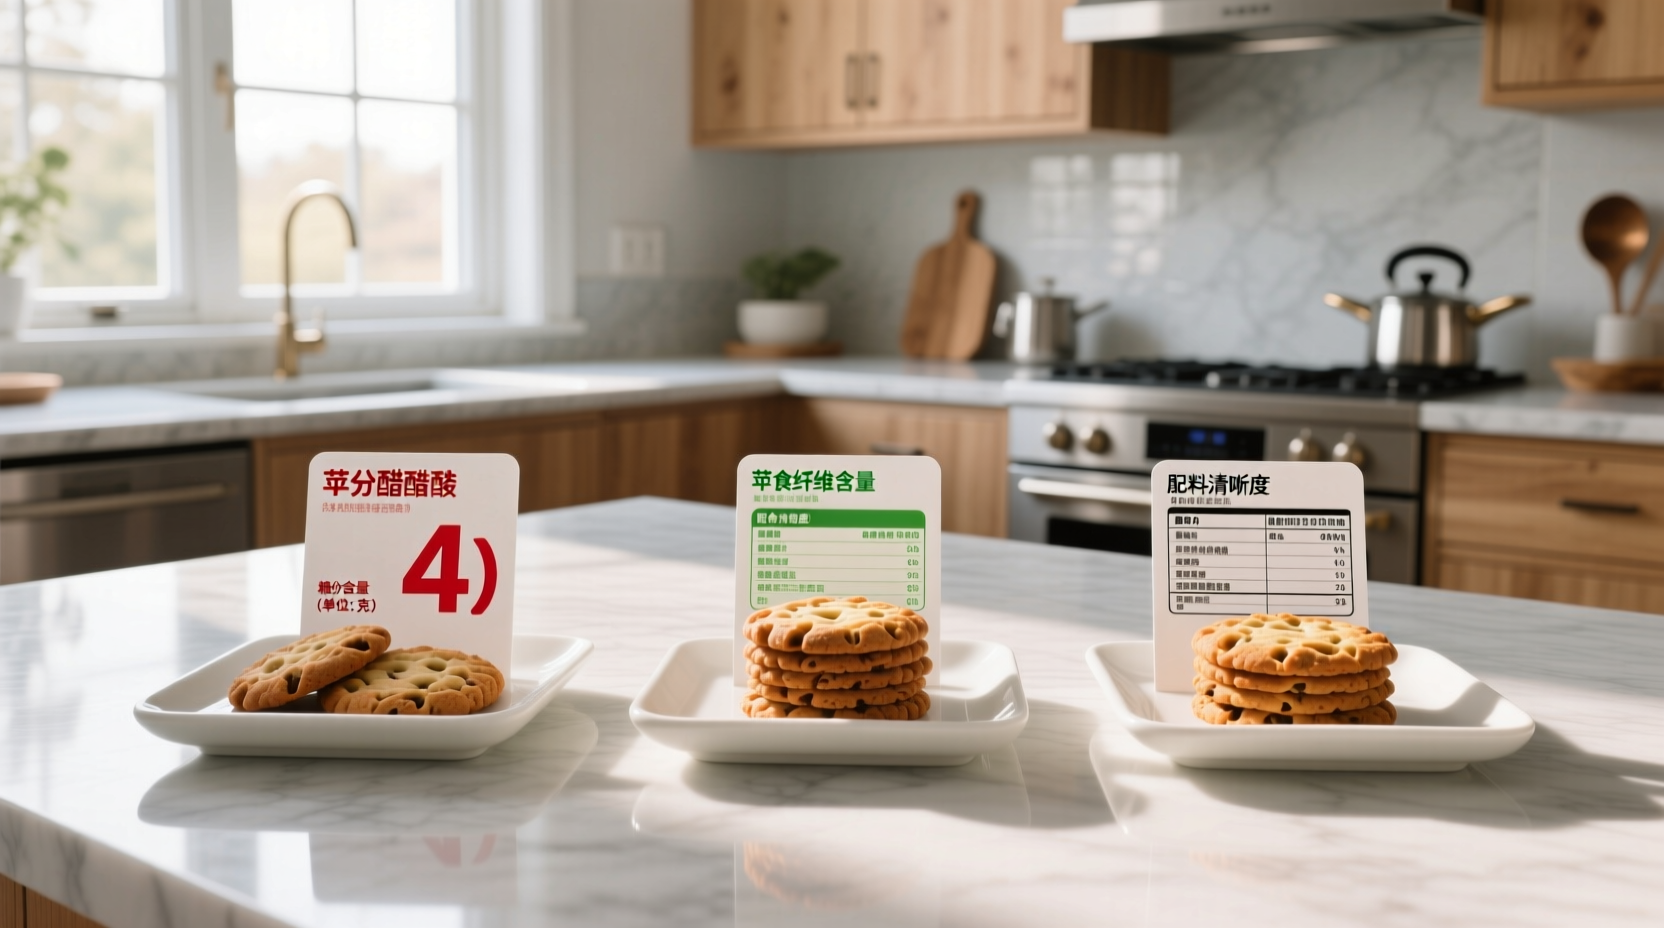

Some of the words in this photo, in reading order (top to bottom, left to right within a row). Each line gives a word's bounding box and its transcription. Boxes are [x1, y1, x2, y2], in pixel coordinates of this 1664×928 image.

[752, 469, 876, 492] 苹食纤维含量
